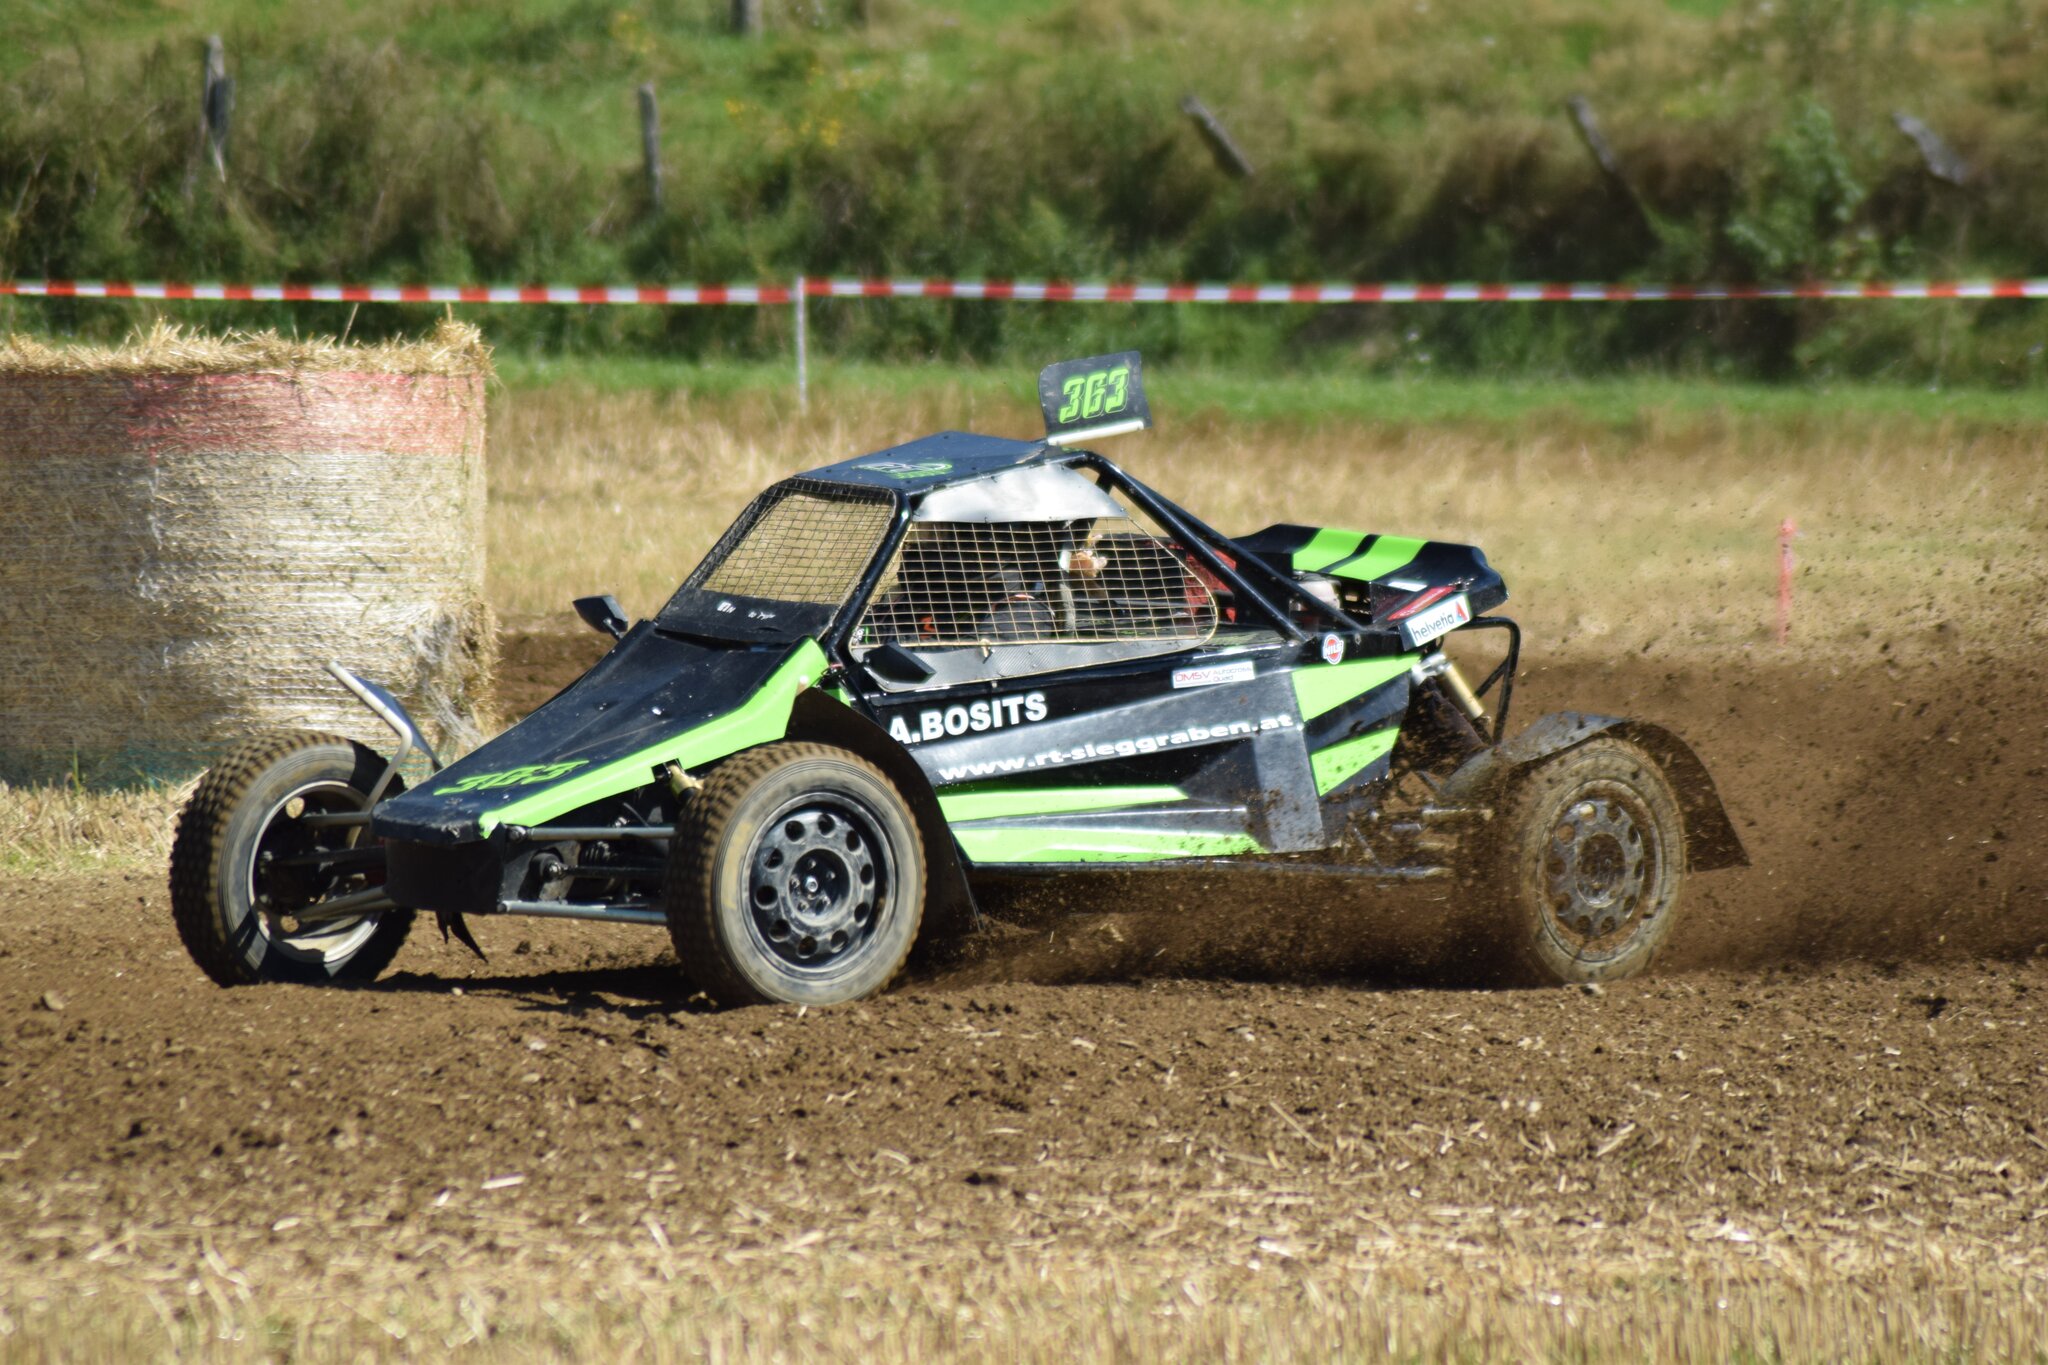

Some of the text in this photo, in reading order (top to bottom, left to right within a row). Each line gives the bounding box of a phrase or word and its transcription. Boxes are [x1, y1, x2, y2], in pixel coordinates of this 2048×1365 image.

[1059, 368, 1129, 424] 363
[1411, 612, 1455, 642] helvetia
[889, 691, 1048, 744] A.BOSITS
